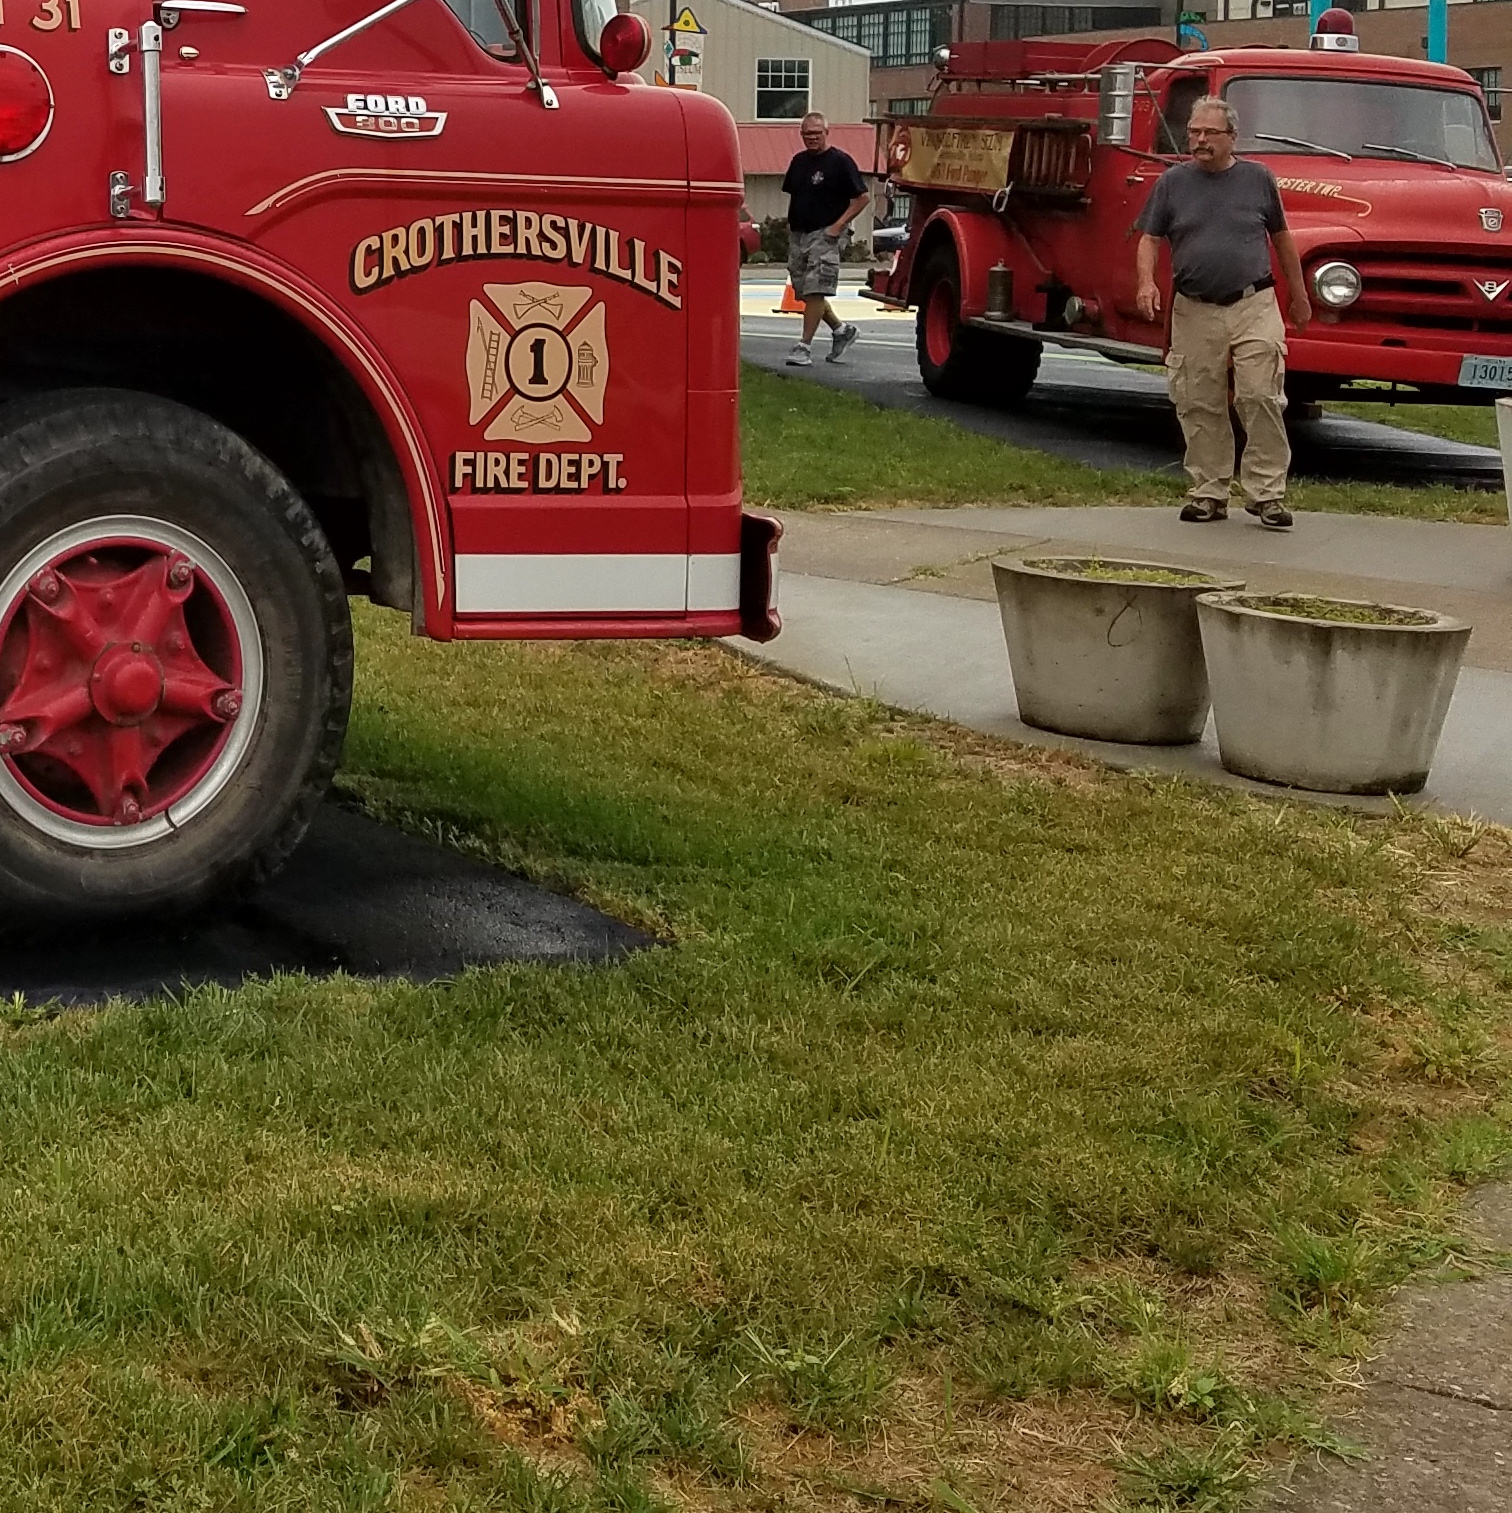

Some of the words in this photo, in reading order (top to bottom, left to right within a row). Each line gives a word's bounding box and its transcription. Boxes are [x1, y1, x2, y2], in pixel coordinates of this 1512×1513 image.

[346, 93, 427, 116] FORD
[350, 209, 683, 310] CROTHERSVILLE
[529, 338, 549, 386] 1
[450, 451, 530, 490] FIRE
[536, 452, 628, 491] DEPT.
